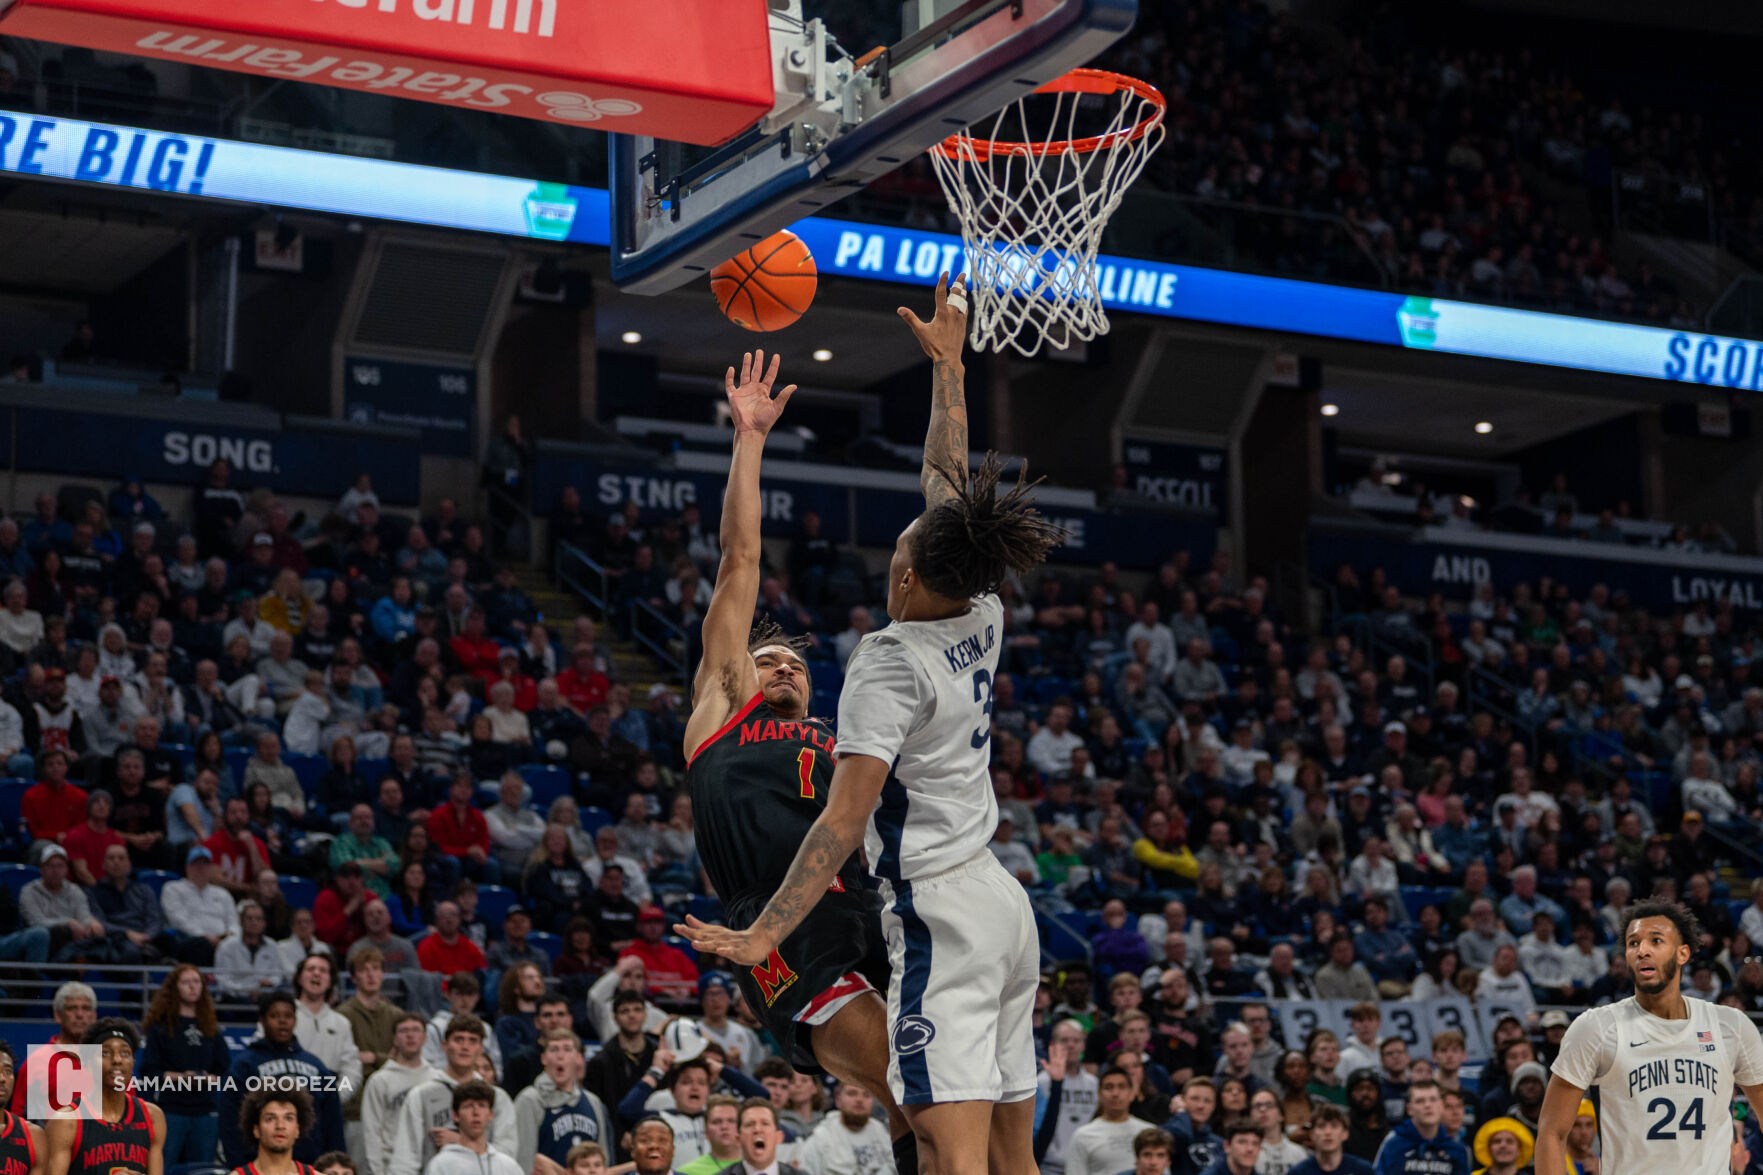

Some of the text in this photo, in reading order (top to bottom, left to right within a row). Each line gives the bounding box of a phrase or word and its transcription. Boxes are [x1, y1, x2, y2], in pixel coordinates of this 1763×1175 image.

[74, 127, 215, 195] BIG!
[835, 231, 885, 271] PA
[1432, 553, 1491, 585] AND
[944, 624, 995, 673] KERN JR
[970, 668, 993, 749] 3
[738, 719, 838, 766] MARYLA
[797, 746, 816, 799] 1
[1390, 1009, 1418, 1046] 3
[1629, 1059, 1719, 1098] PENN STATE
[1646, 1097, 1706, 1140] 24
